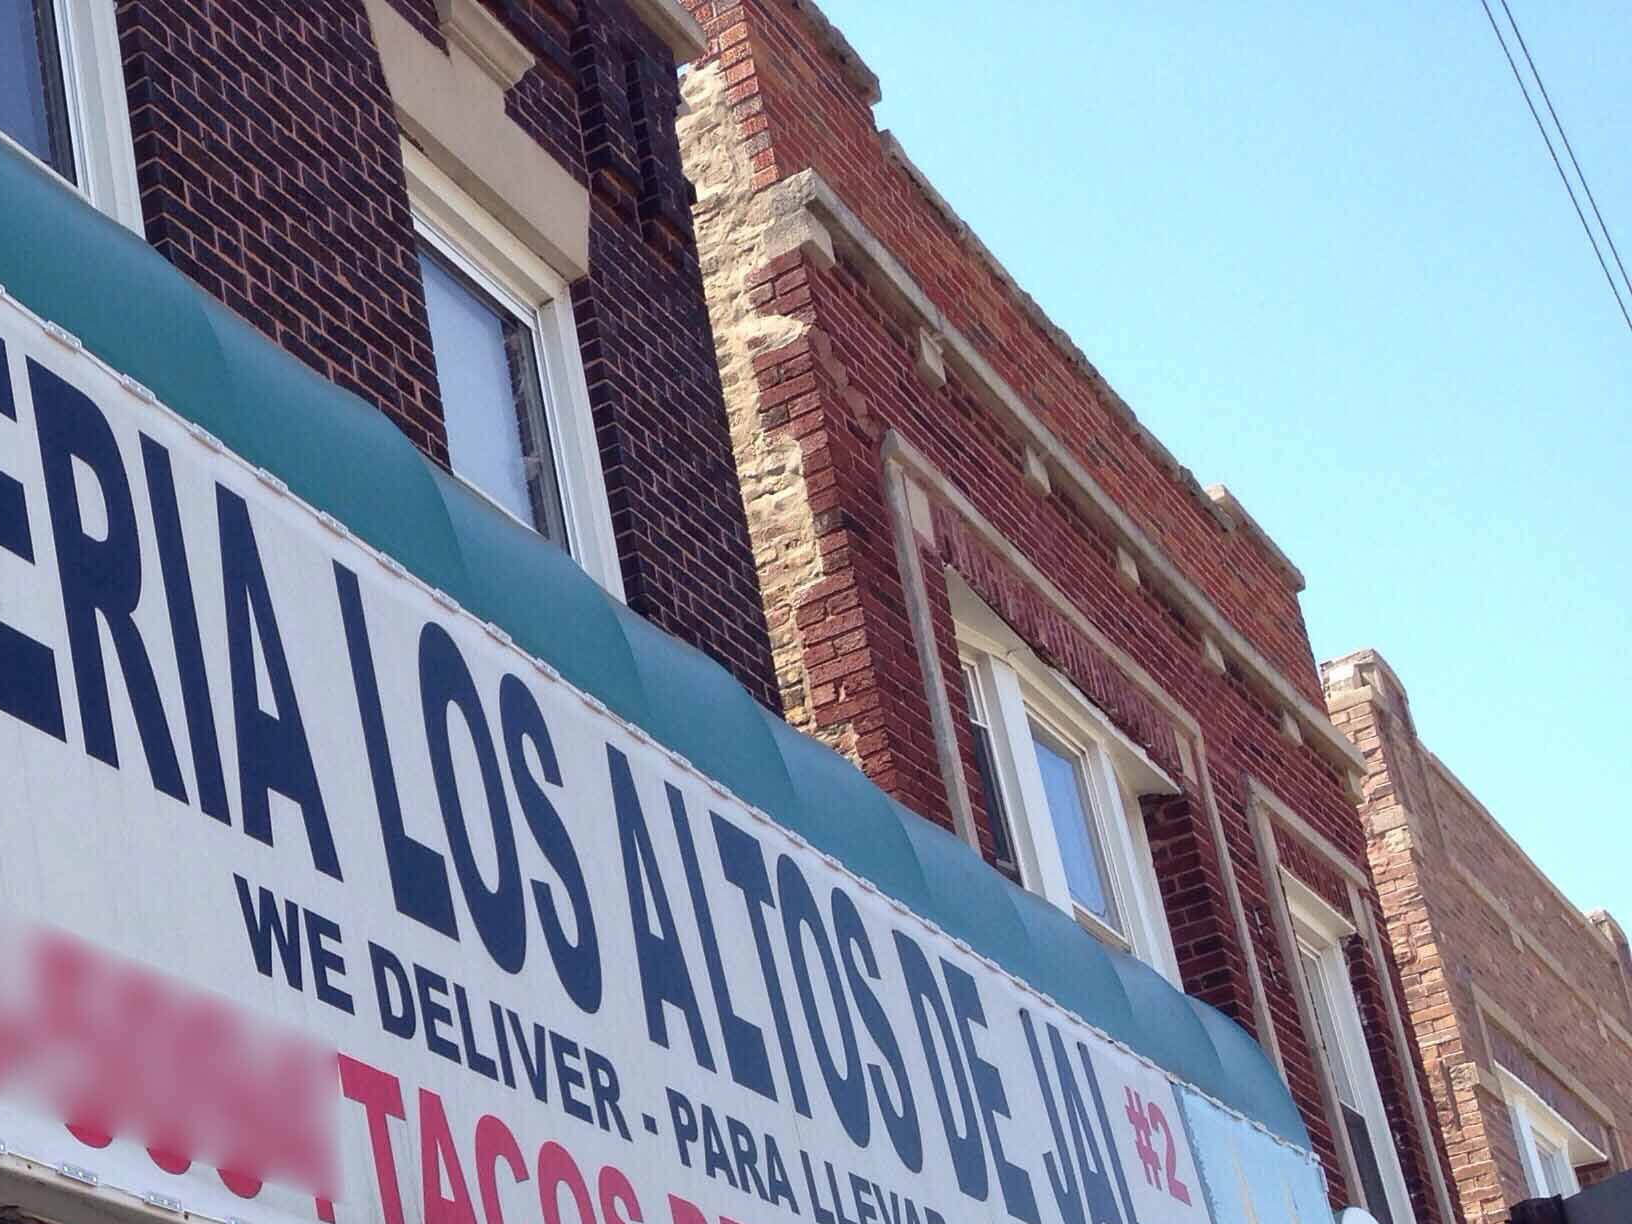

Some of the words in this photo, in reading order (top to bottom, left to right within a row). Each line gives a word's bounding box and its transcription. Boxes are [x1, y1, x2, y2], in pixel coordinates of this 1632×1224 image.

[232, 872, 356, 1017] WE
[368, 940, 634, 1143] DELIVER
[665, 1086, 801, 1214] PARA
[334, 559, 603, 1014] LOS
[605, 742, 923, 1175] ALTOS
[1123, 1084, 1193, 1208] #2
